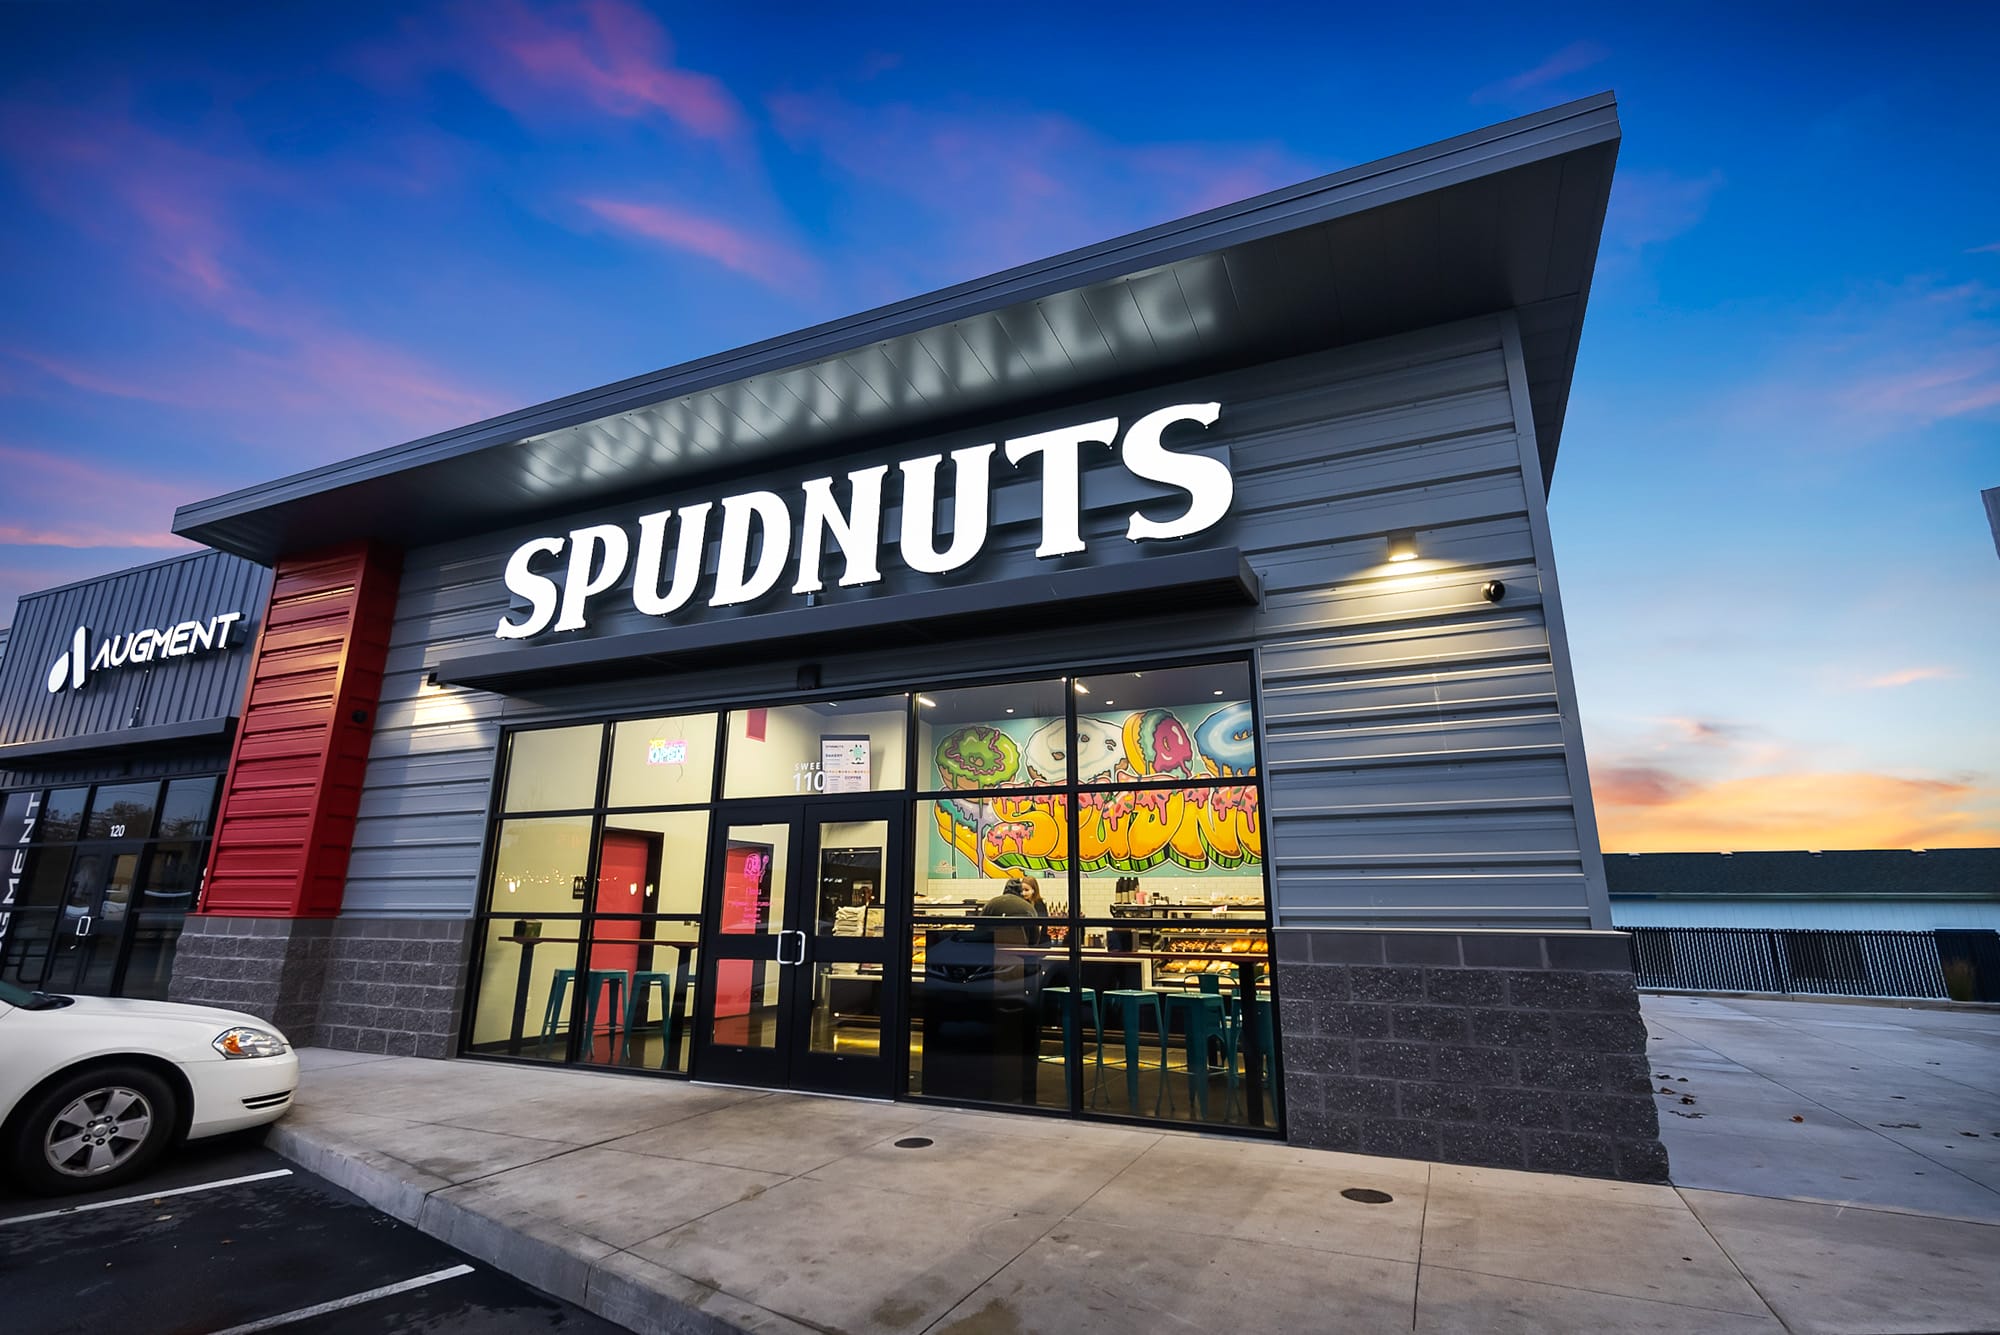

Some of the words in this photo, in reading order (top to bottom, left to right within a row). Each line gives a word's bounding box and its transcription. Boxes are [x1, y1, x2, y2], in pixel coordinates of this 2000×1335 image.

[494, 402, 1234, 638] SPUDNUTS
[91, 611, 241, 671] AUGMENT
[793, 770, 826, 792] 110
[110, 824, 125, 838] 120
[0, 792, 41, 953] GMENT
